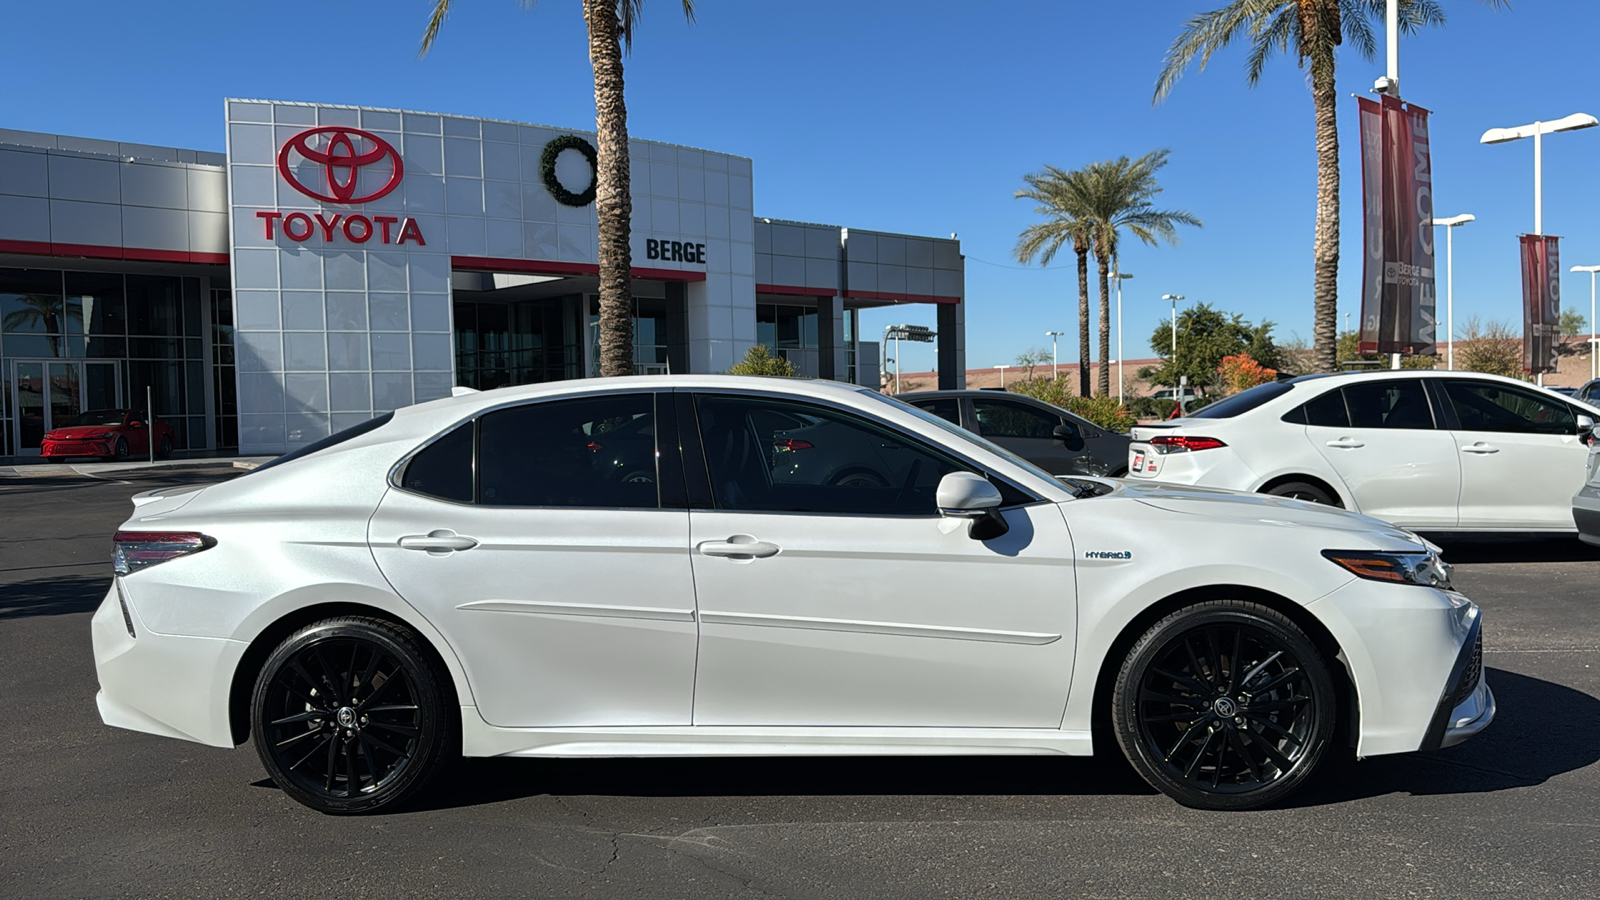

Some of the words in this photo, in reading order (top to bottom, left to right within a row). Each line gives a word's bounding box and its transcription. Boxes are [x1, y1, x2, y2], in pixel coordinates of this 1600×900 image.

[256, 211, 426, 245] TOYOTA
[646, 238, 706, 264] BERGE
[1398, 261, 1420, 276] BERGE
[1085, 551, 1124, 559] HYBRID
